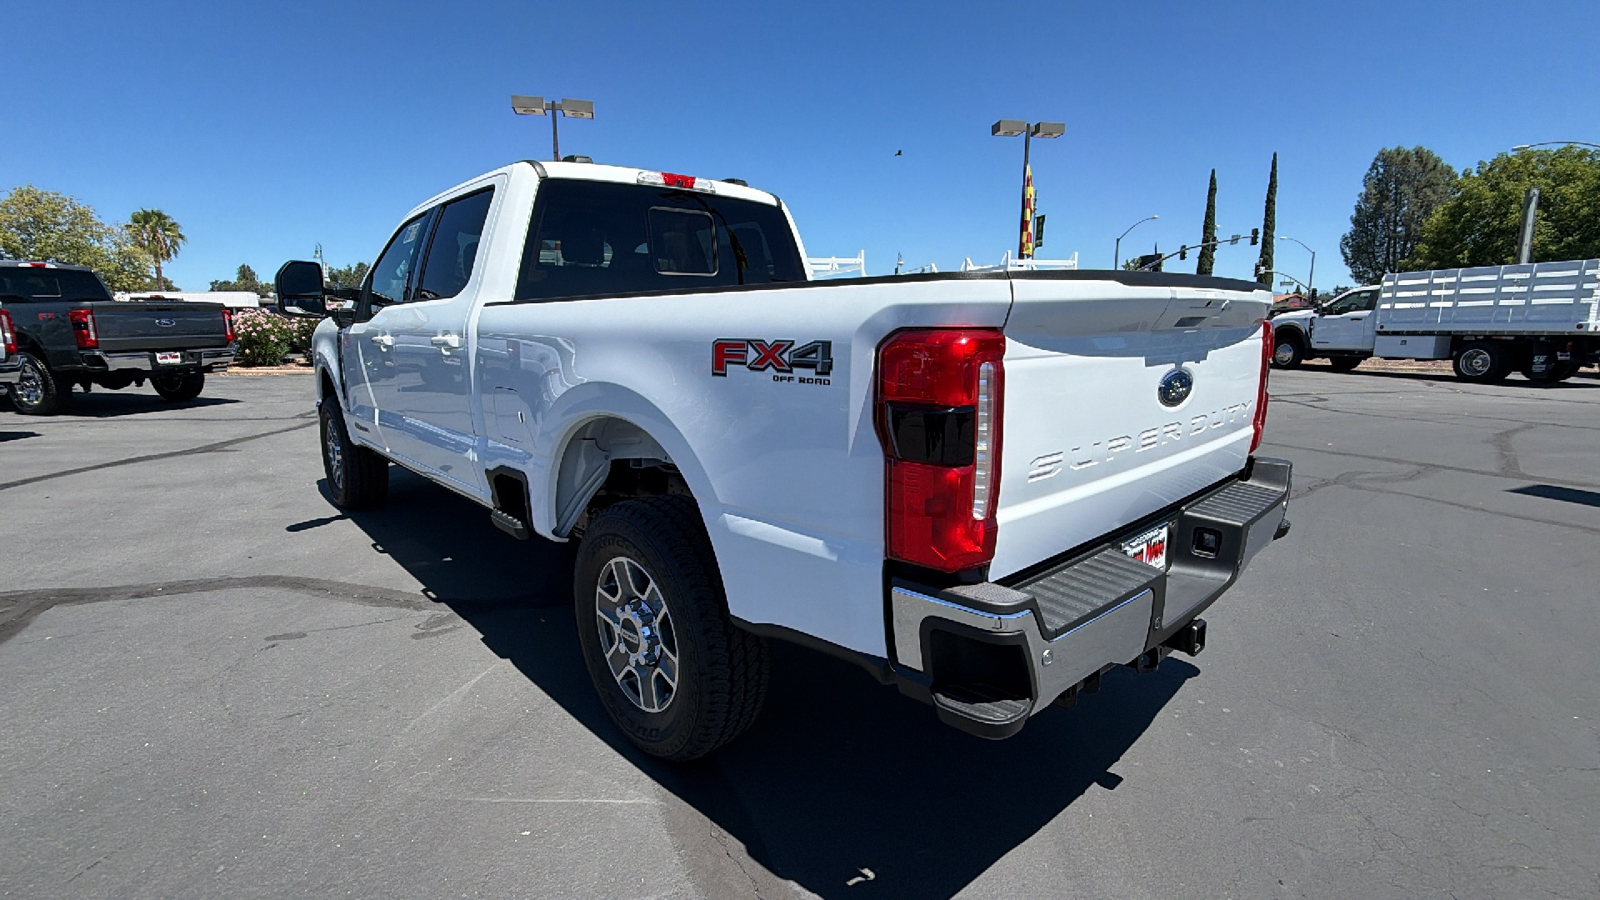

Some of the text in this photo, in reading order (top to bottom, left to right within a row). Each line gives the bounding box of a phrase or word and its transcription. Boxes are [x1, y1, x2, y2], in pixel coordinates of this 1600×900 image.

[712, 338, 833, 377] FX4
[773, 374, 831, 386] OFF ROAD
[1027, 400, 1252, 483] SUPER DUTY
